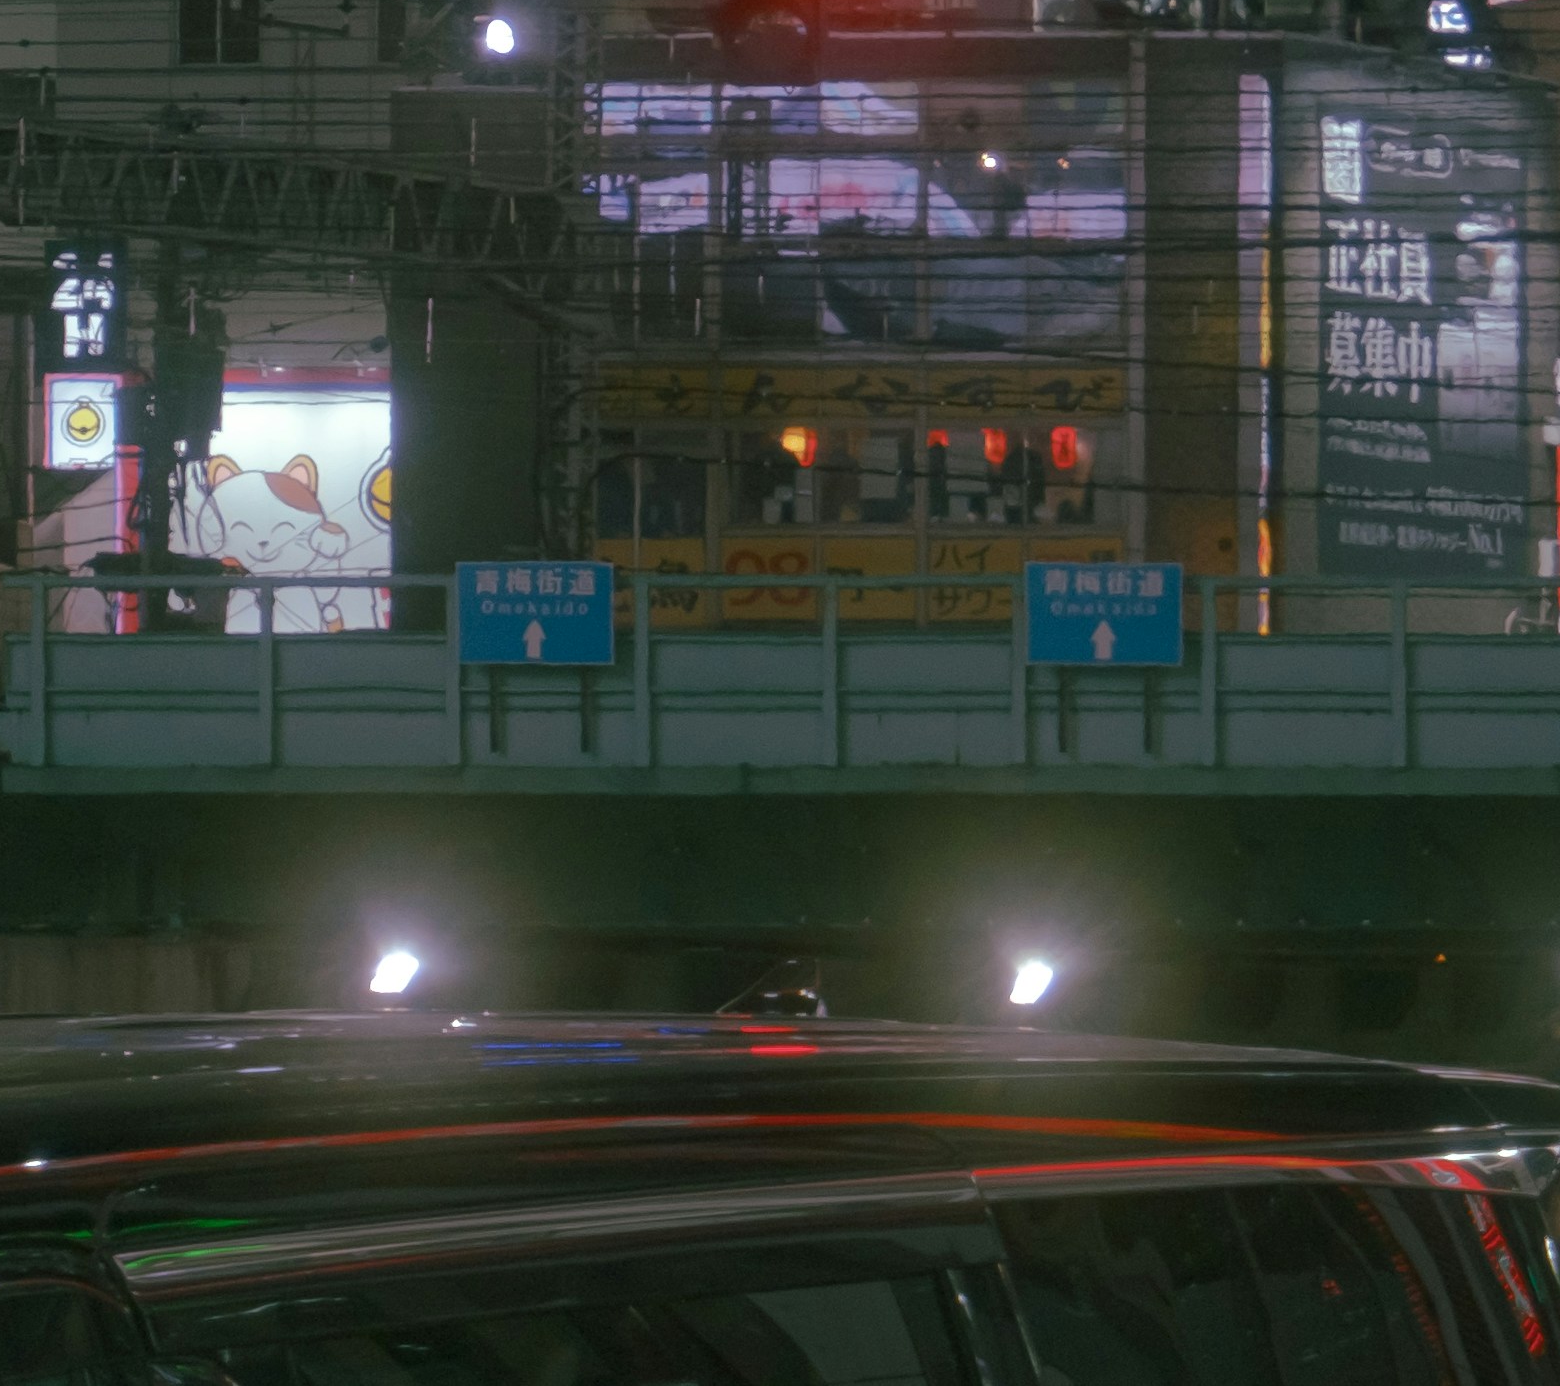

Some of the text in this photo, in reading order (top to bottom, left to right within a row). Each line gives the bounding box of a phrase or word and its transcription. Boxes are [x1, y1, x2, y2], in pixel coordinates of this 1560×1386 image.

[475, 567, 596, 597] 青梅街道
[1044, 568, 1164, 598] 青梅街道
